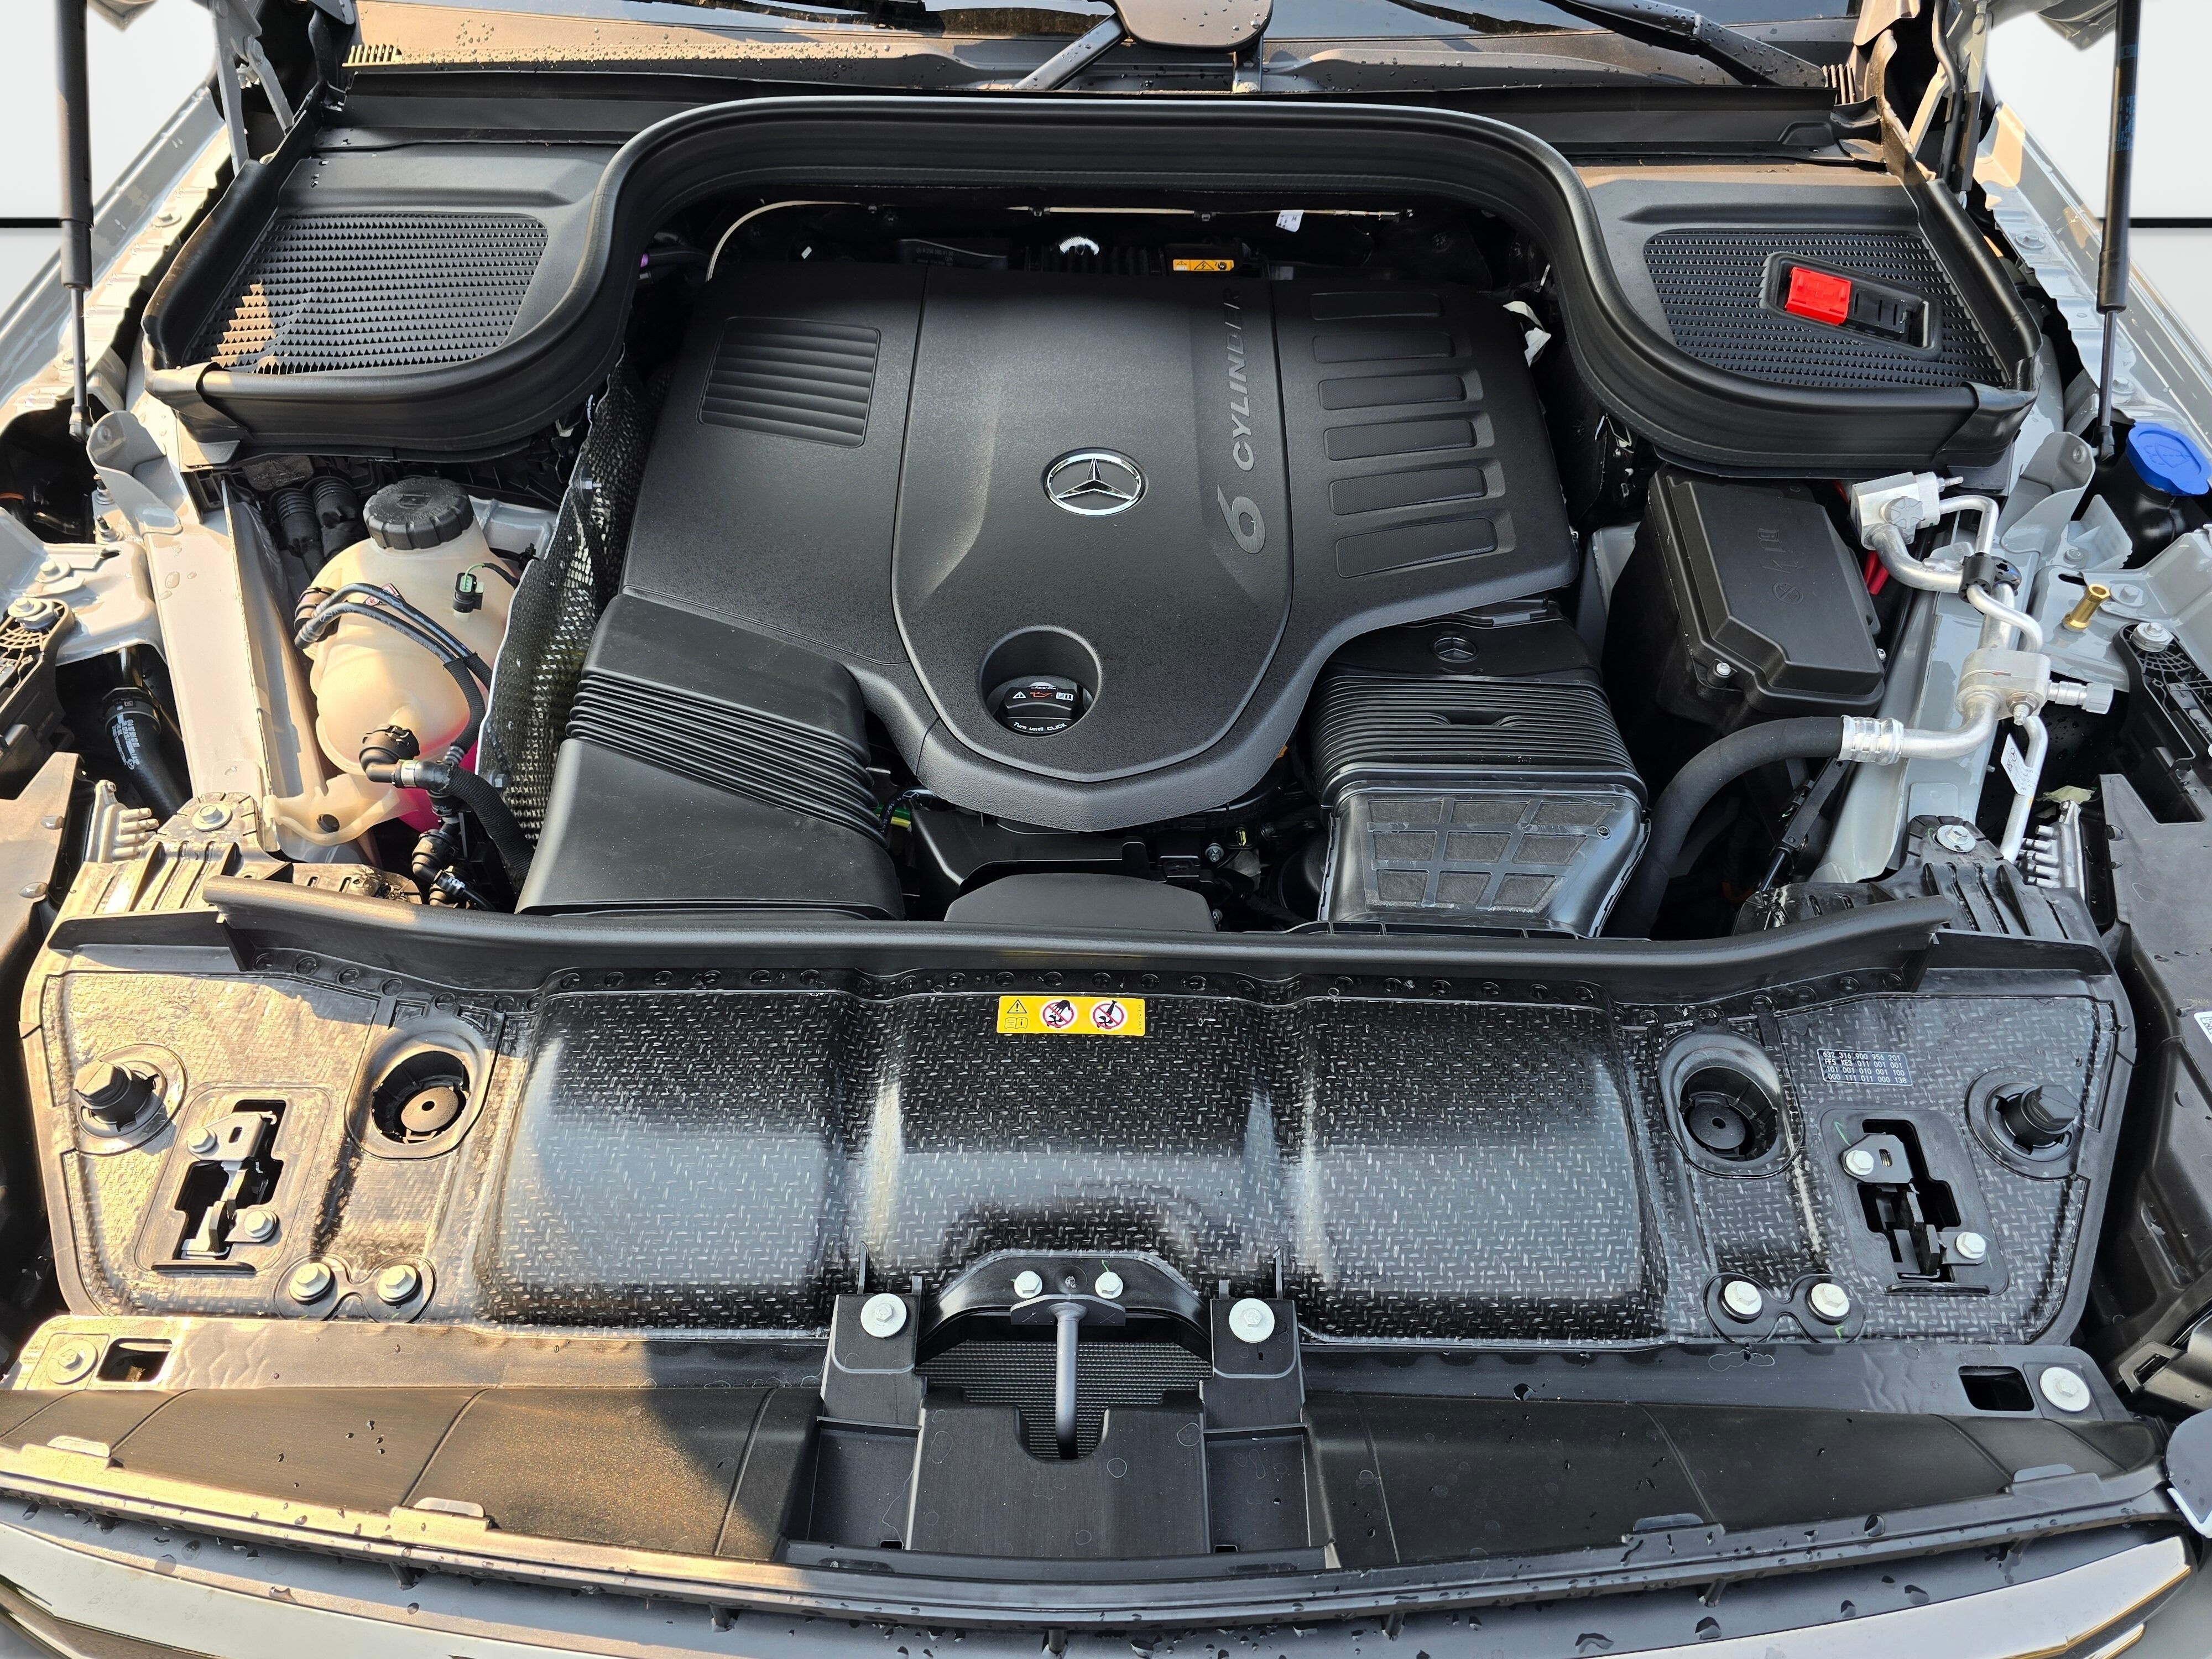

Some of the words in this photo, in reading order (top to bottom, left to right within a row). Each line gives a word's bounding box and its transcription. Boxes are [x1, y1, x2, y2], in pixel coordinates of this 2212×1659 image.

[1223, 286, 1254, 471] CYLINDER
[1217, 484, 1266, 554] 6
[1013, 722, 1027, 730] Turn
